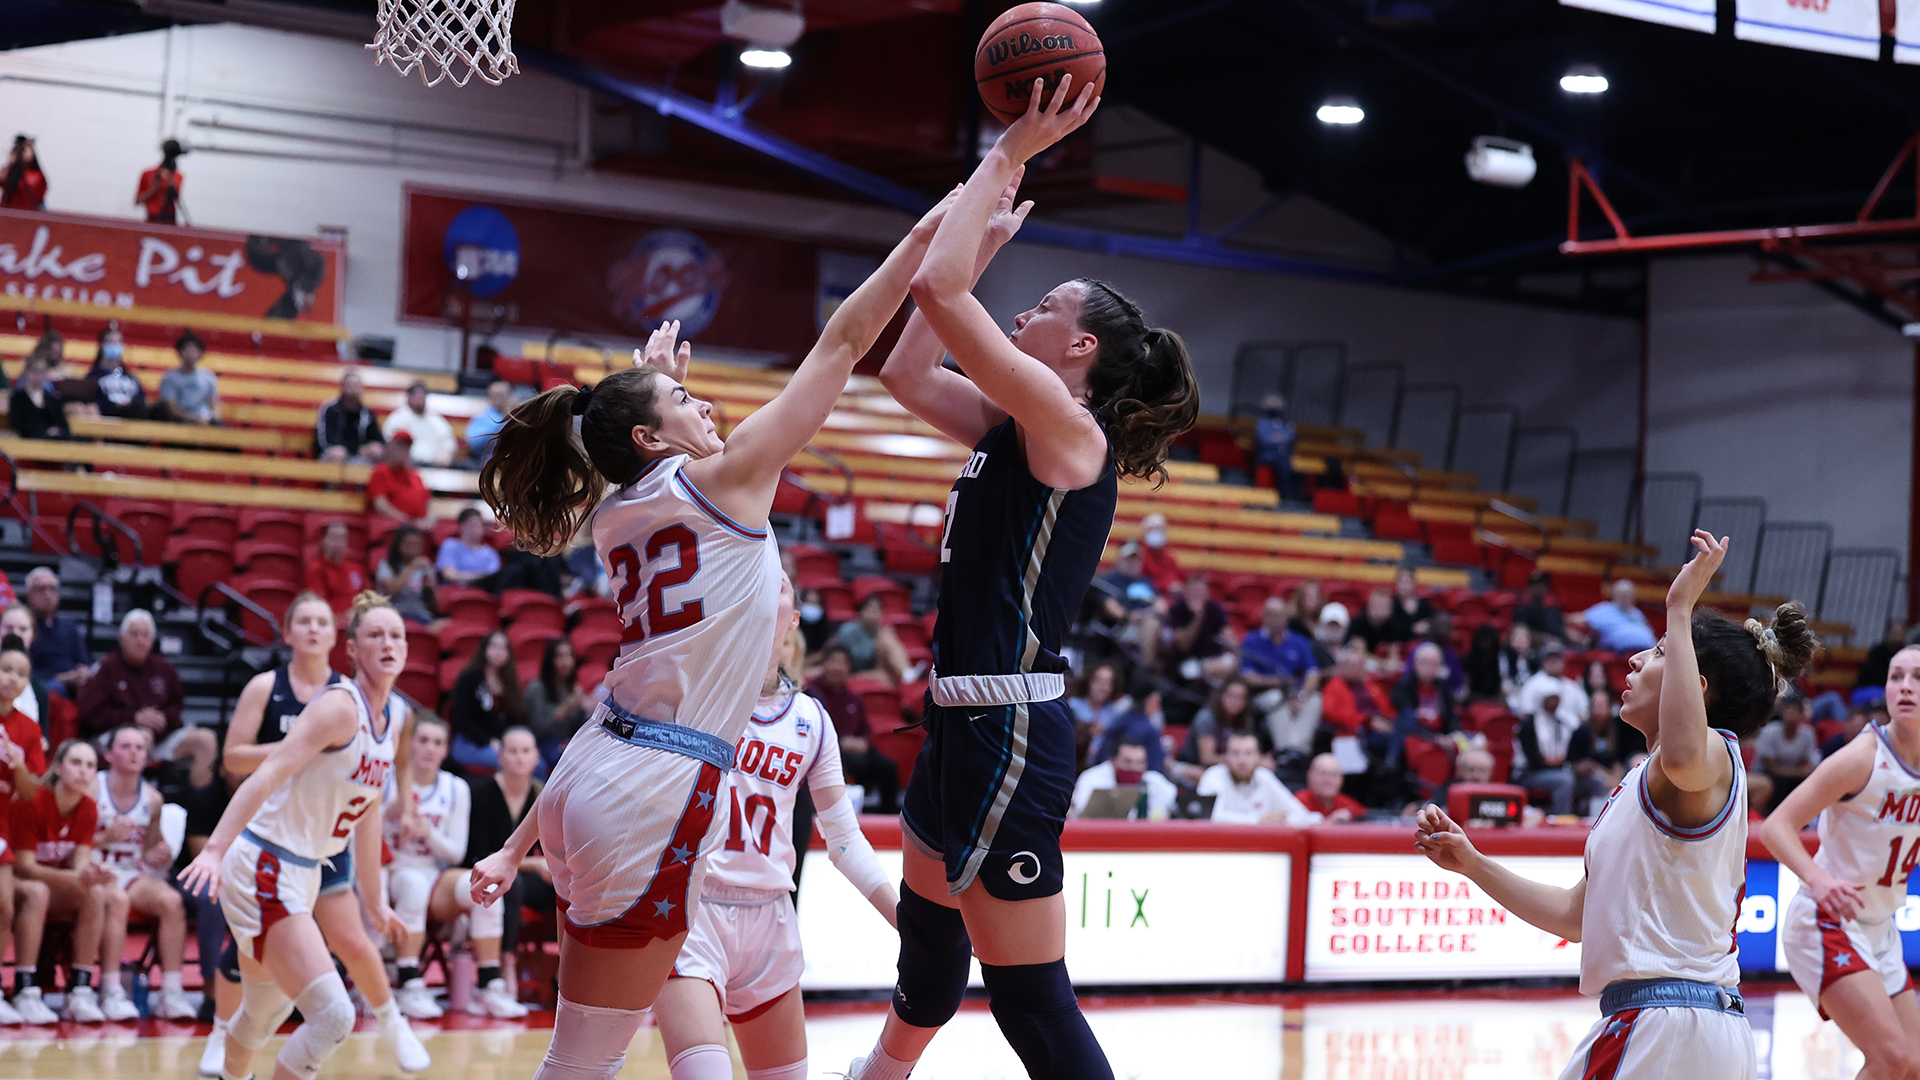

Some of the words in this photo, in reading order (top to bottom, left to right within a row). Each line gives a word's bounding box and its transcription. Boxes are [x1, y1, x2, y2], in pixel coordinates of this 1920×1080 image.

[985, 32, 1076, 67] Wilson
[135, 236, 246, 298] Pit
[607, 521, 706, 647] 22
[723, 786, 777, 857] 10
[1876, 835, 1920, 888] 14
[1332, 880, 1472, 900] FLORIDA
[1331, 907, 1507, 927] SOUTHERN
[1330, 934, 1477, 954] COLLEGE
